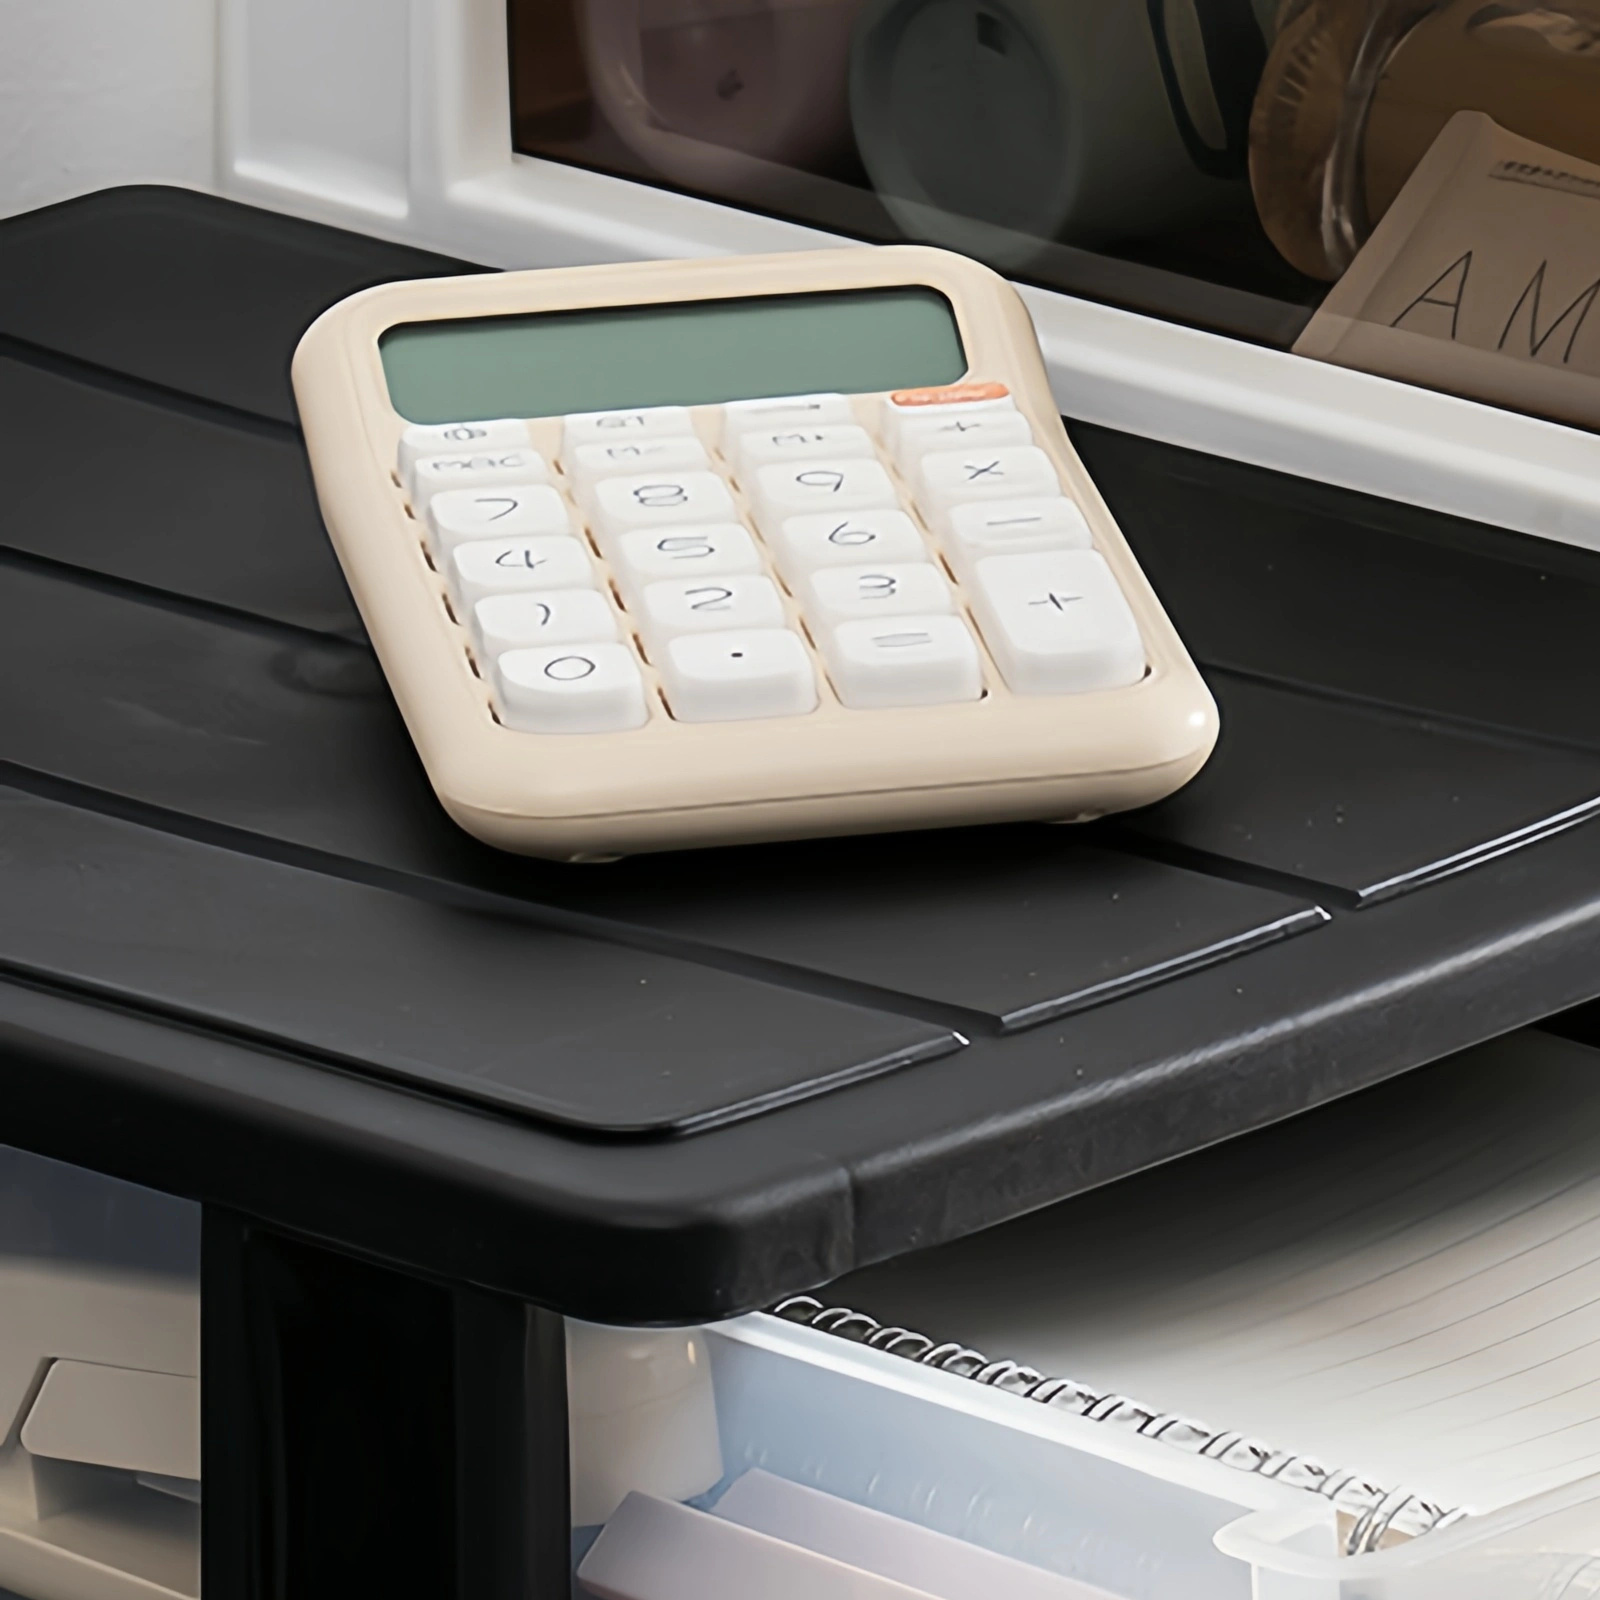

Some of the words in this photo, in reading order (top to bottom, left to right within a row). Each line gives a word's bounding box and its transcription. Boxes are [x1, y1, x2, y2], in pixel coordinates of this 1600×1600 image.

[796, 470, 845, 493] 9
[632, 484, 689, 507] 8
[474, 497, 519, 522] 7
[827, 521, 877, 546] 6
[494, 549, 547, 570] 4
[656, 535, 716, 561] 5
[684, 586, 734, 612] 2
[857, 573, 897, 600] 3
[536, 602, 551, 626] 1
[543, 655, 597, 682] 0
